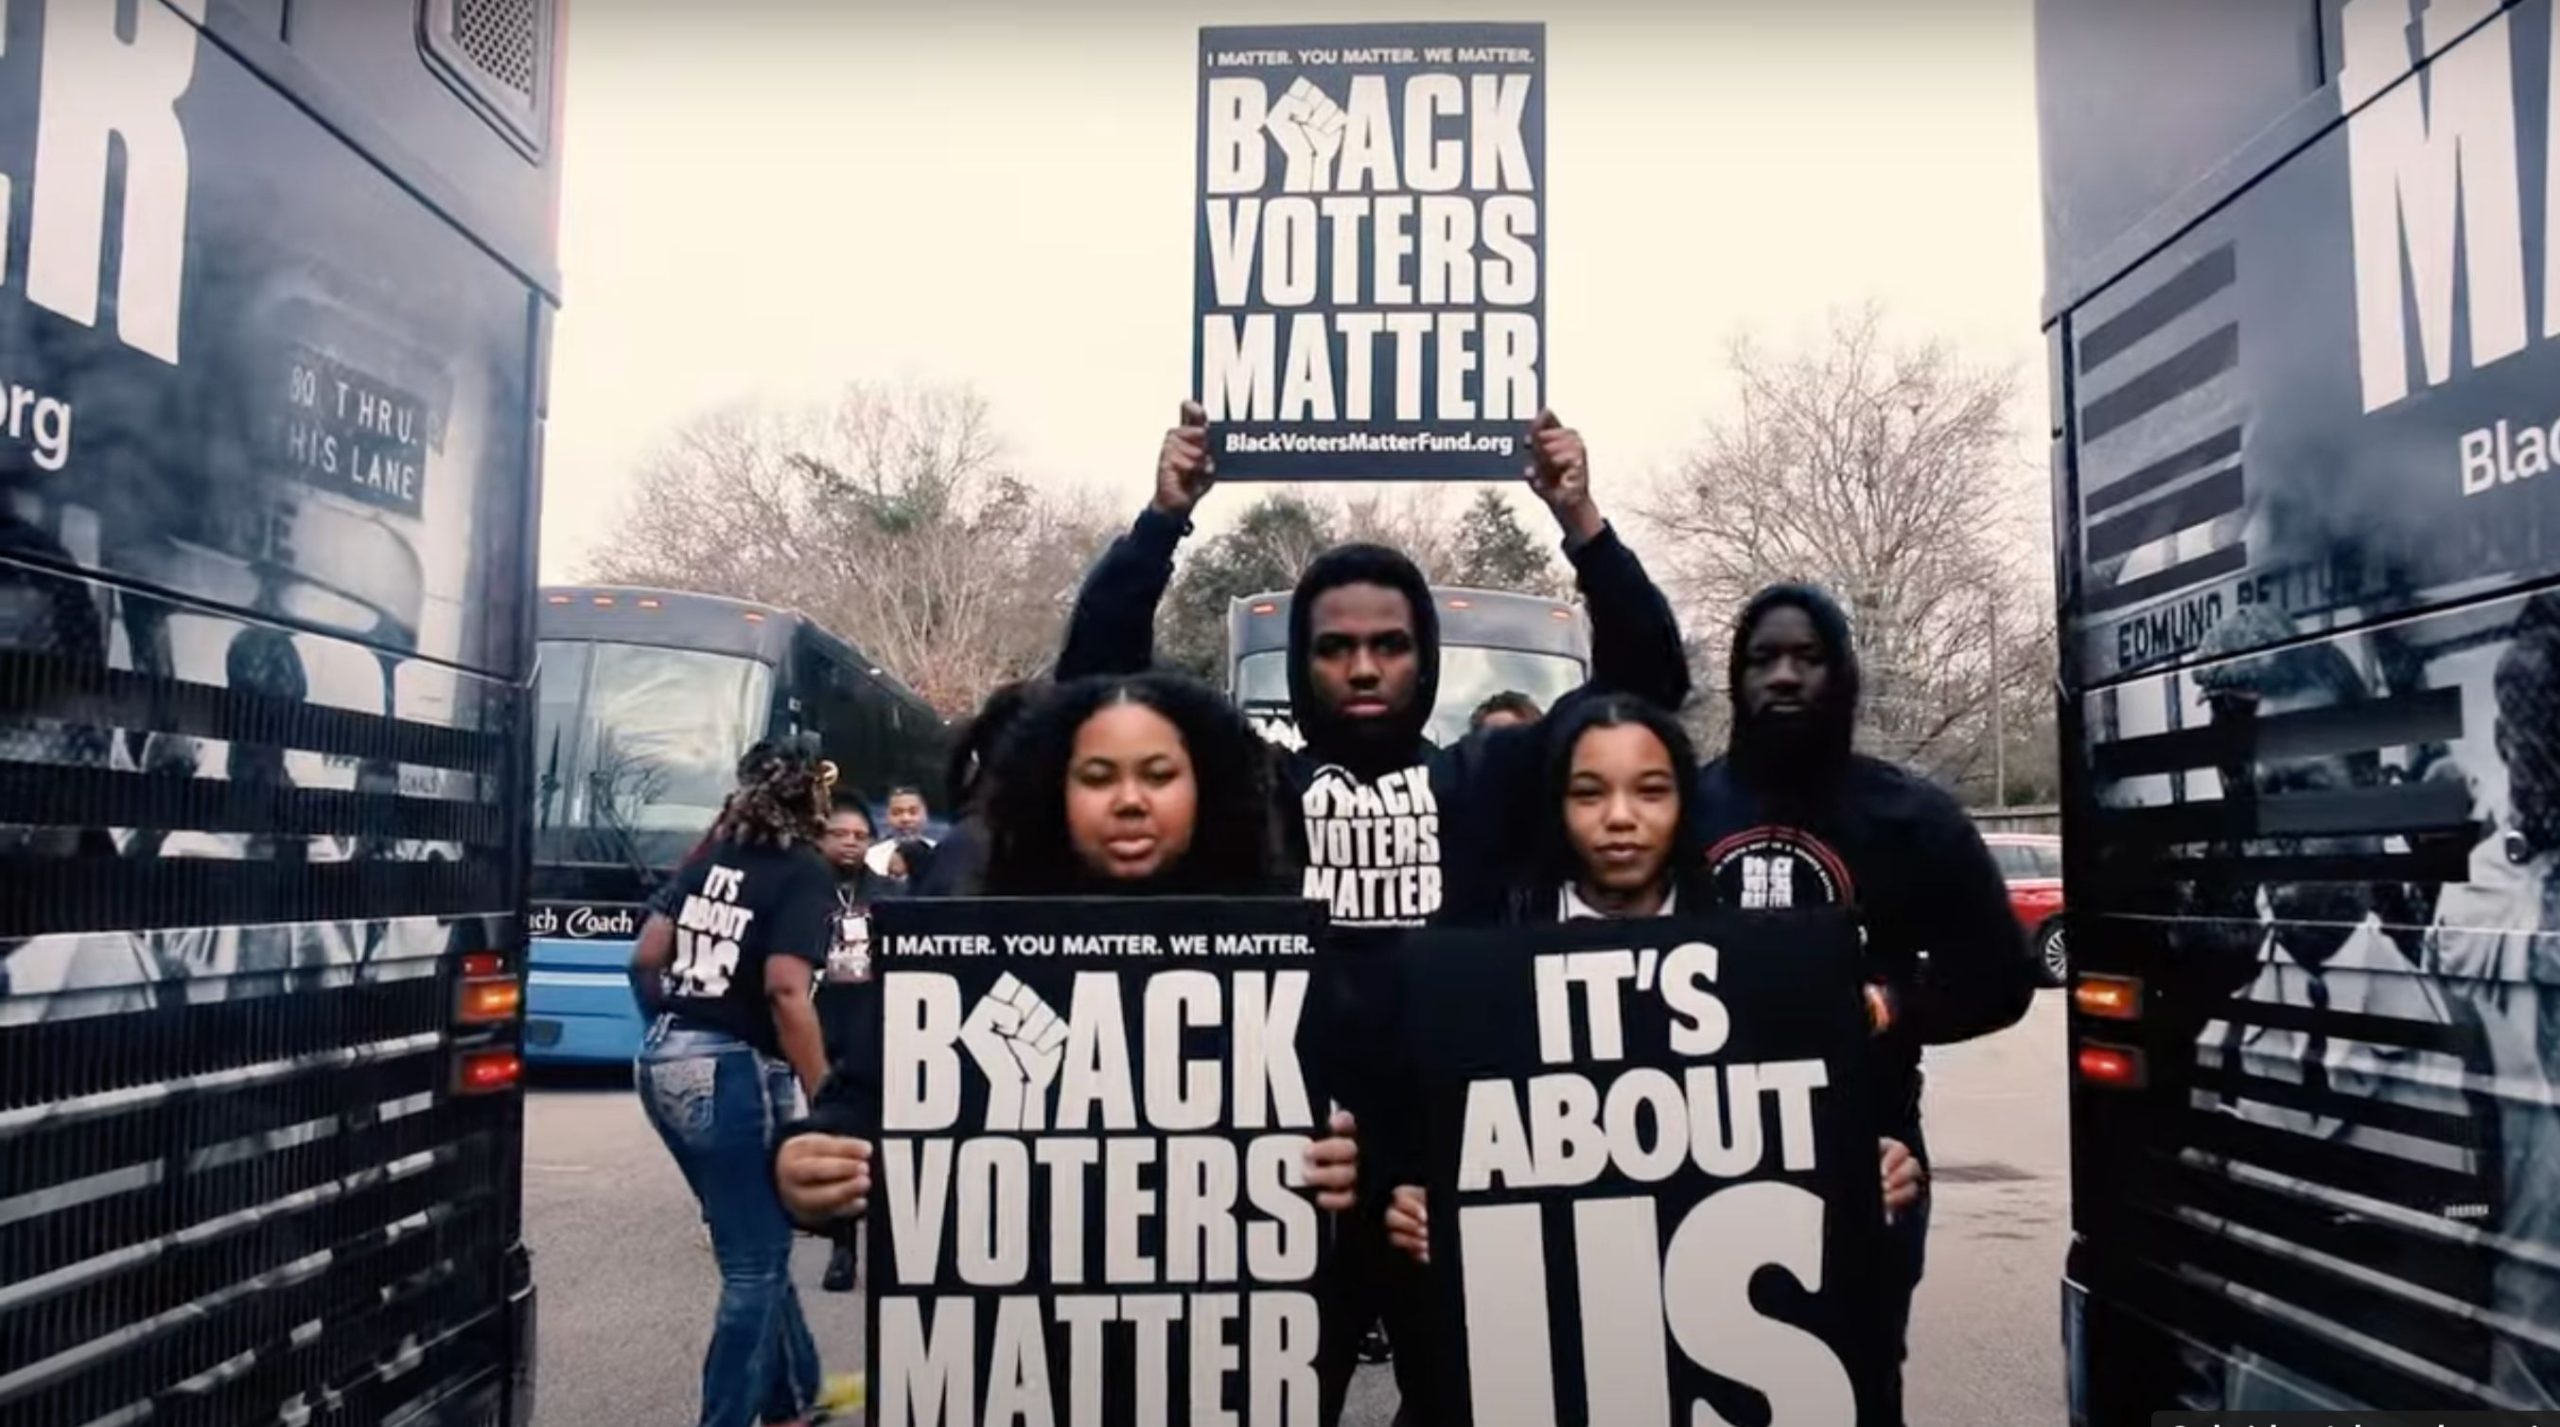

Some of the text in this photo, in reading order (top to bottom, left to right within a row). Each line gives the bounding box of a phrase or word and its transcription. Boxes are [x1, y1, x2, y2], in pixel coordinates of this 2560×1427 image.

[1207, 48, 1535, 66] I MATTER. YOU MATTER. WE MATTER.
[1207, 73, 1534, 193] BACK
[1206, 195, 1537, 306] VOTERS
[1203, 312, 1538, 422] MATTER
[0, 380, 71, 470] rg
[351, 445, 415, 500] LANE
[1225, 433, 1513, 455] BlackVotersMatterFund.org
[1305, 815, 1441, 867] VOTERS
[565, 906, 633, 937] Coach
[677, 894, 754, 942] ABOUT
[1302, 865, 1443, 918] MATTER
[883, 936, 889, 954] I
[897, 935, 997, 955] MATTER.
[1003, 935, 1055, 955] YOU
[1063, 935, 1163, 955] MATTER.
[1170, 935, 1208, 955] WE
[1215, 935, 1316, 955] MATTER.
[882, 970, 1314, 1131] BACK
[1534, 942, 1730, 1063] IT'S
[1457, 1059, 1829, 1191] ABOUT
[881, 1134, 1319, 1286] VOTERS
[1458, 1181, 1858, 1427] US
[877, 1290, 1321, 1427] MATTER
